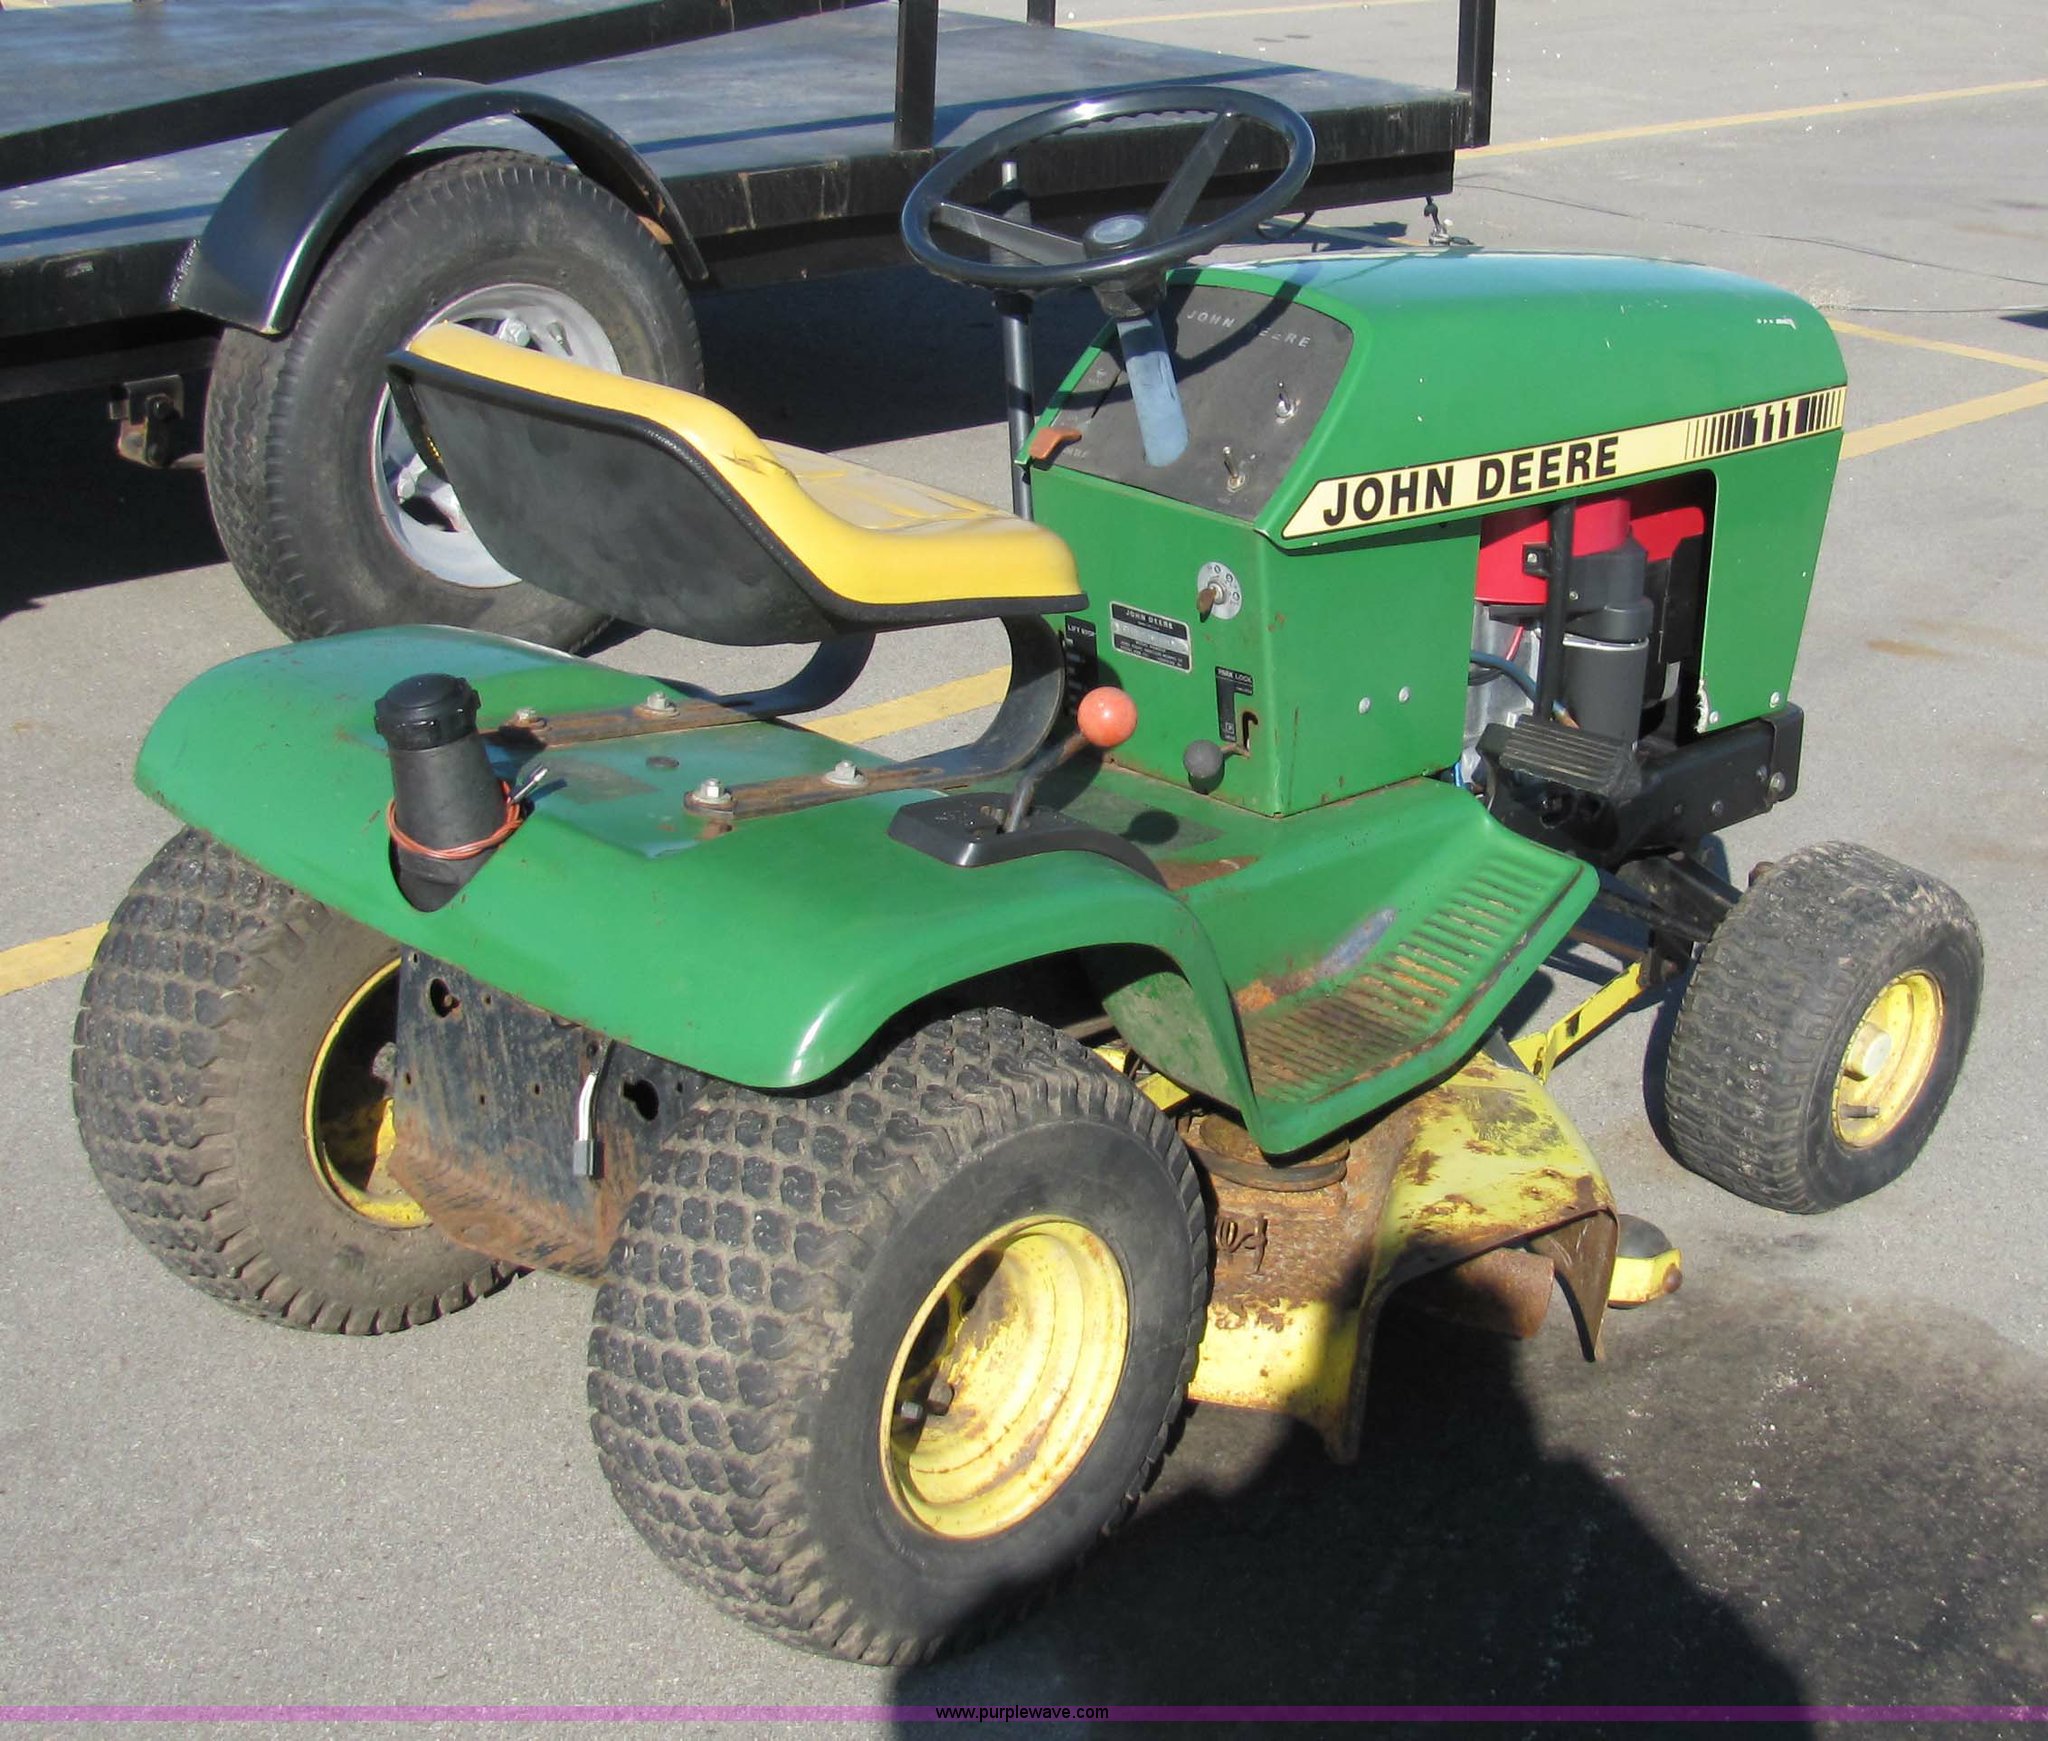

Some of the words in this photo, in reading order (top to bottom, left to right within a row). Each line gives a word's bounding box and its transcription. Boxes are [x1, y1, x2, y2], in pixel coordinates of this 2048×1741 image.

[1187, 310, 1236, 328] JOHN
[1249, 322, 1311, 348] EERE
[1322, 466, 1454, 526] JOHN
[1477, 436, 1619, 500] DEERE
[1125, 609, 1146, 621] JOHN
[1148, 616, 1173, 630] DEERE
